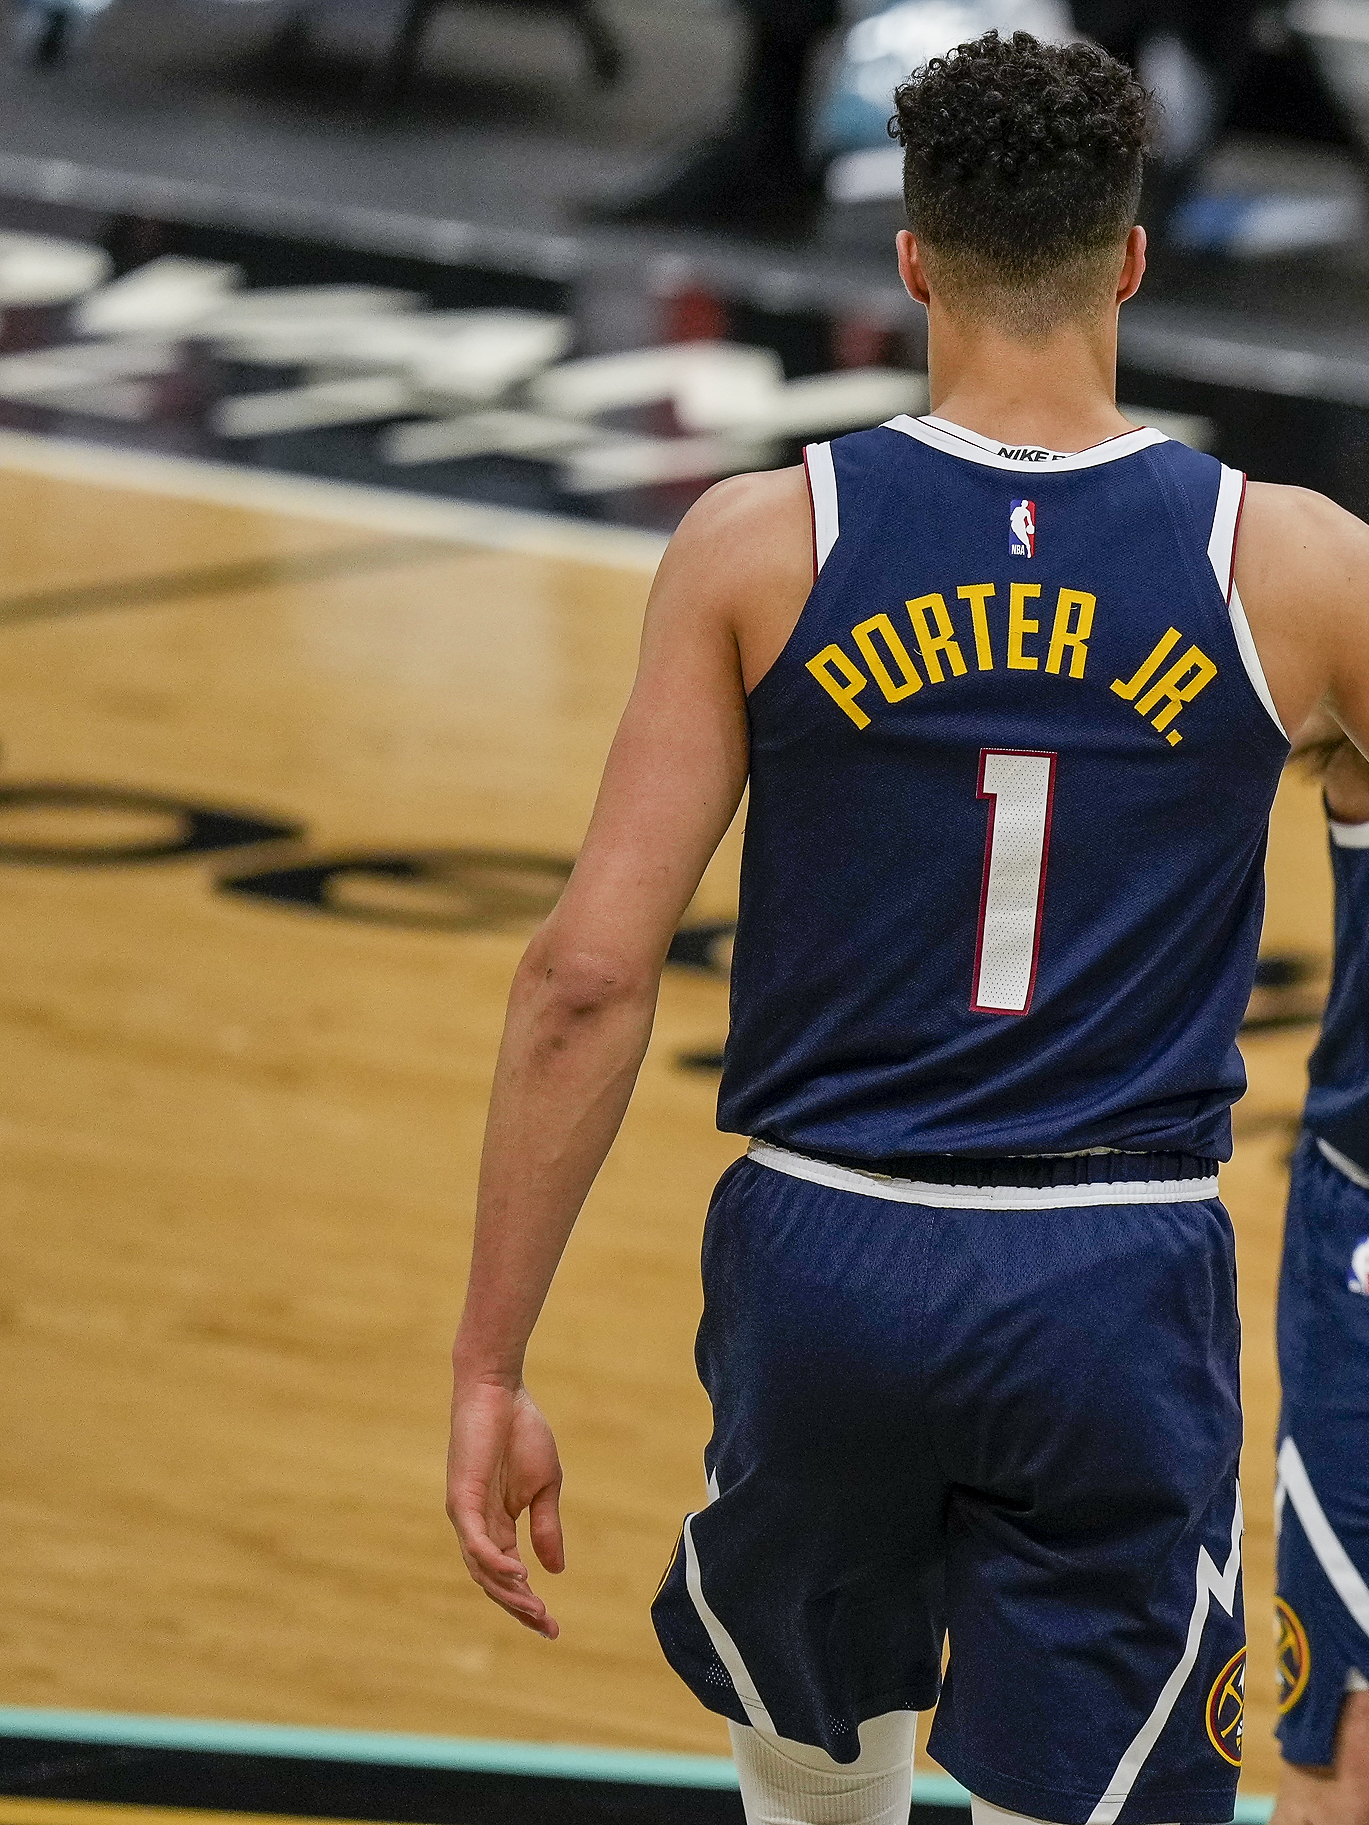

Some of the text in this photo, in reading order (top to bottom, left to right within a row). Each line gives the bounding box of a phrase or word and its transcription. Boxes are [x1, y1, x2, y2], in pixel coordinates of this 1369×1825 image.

[997, 447, 1050, 461] NIKE
[1011, 544, 1026, 556] NBA
[804, 582, 1219, 747] PORTER JR.
[970, 747, 1057, 1016] 1
